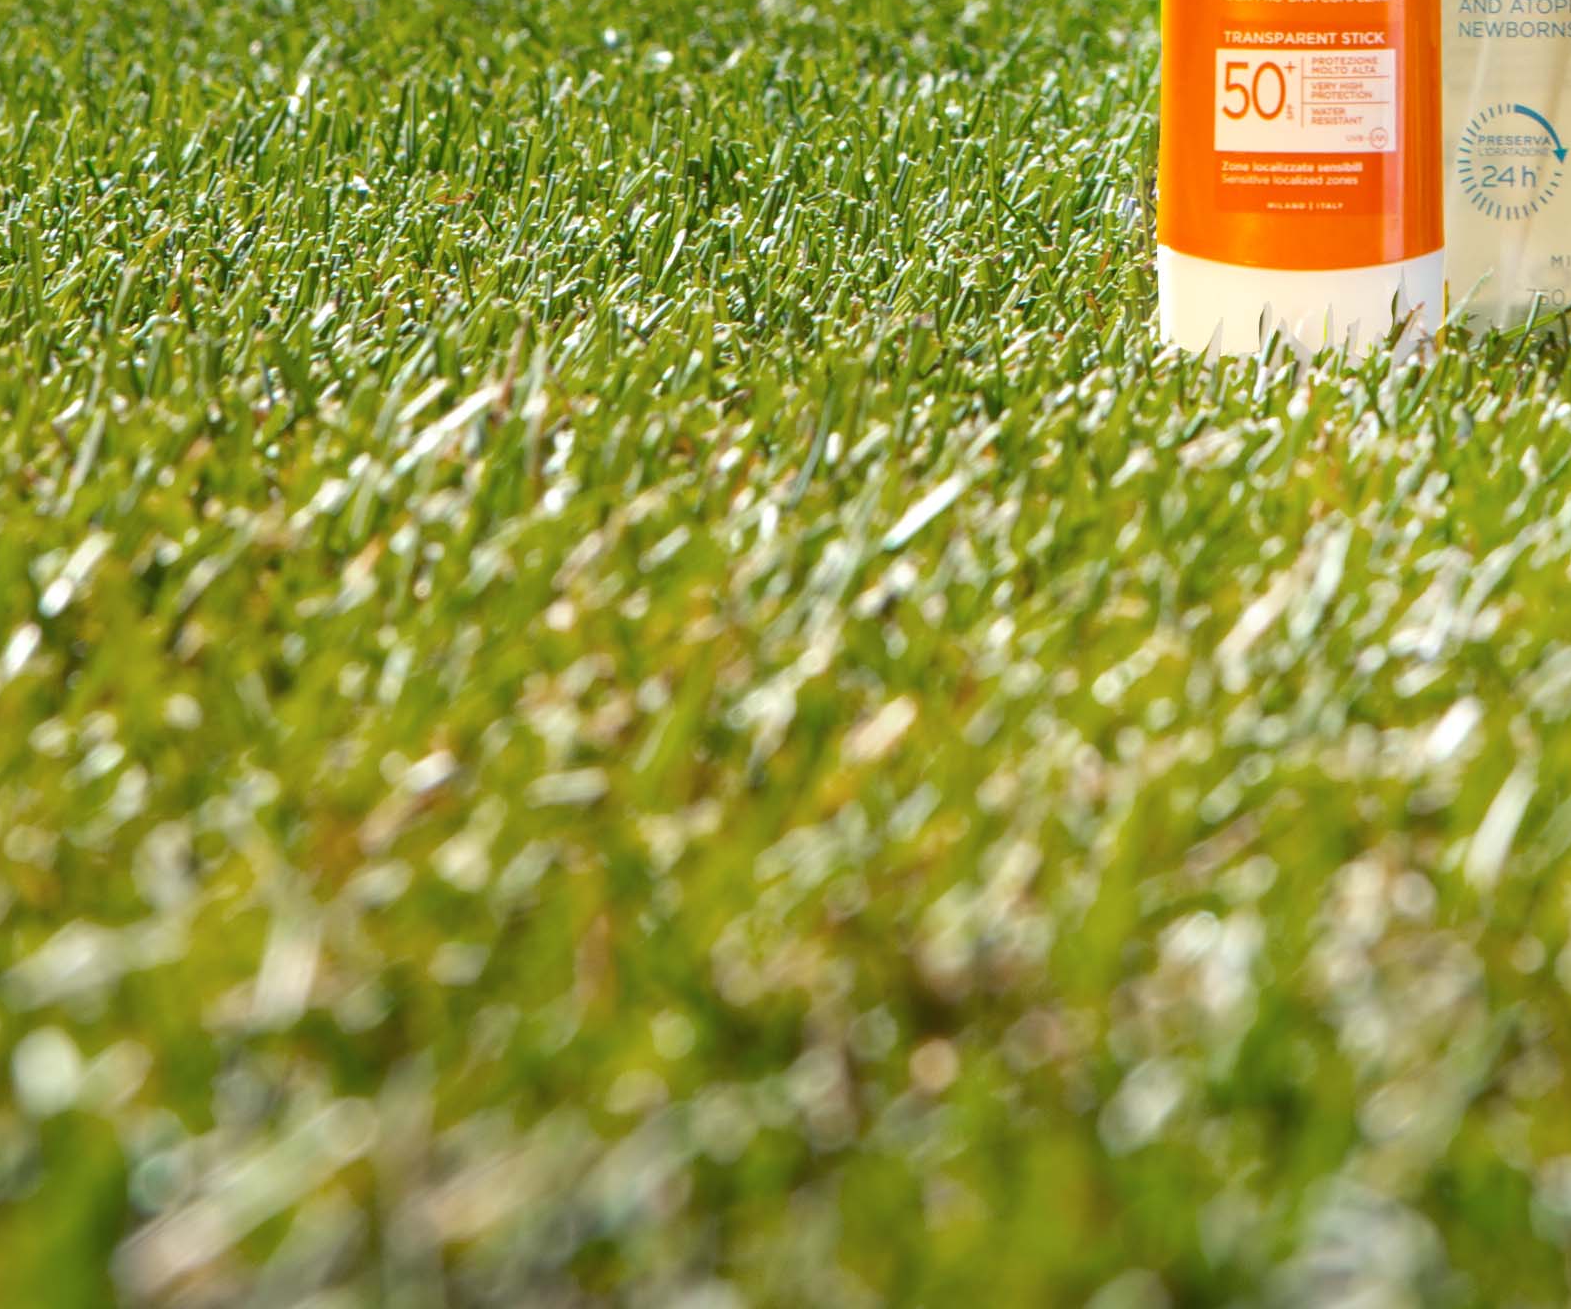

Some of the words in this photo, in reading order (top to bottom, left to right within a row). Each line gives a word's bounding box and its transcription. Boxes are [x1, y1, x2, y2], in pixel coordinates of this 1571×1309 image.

[1224, 31, 1335, 44] TRANSPARENT
[1342, 32, 1385, 44] STICK
[1311, 57, 1378, 65] PROTEZIONE
[1478, 135, 1551, 146] PRESERVA
[1222, 161, 1249, 171] Zone
